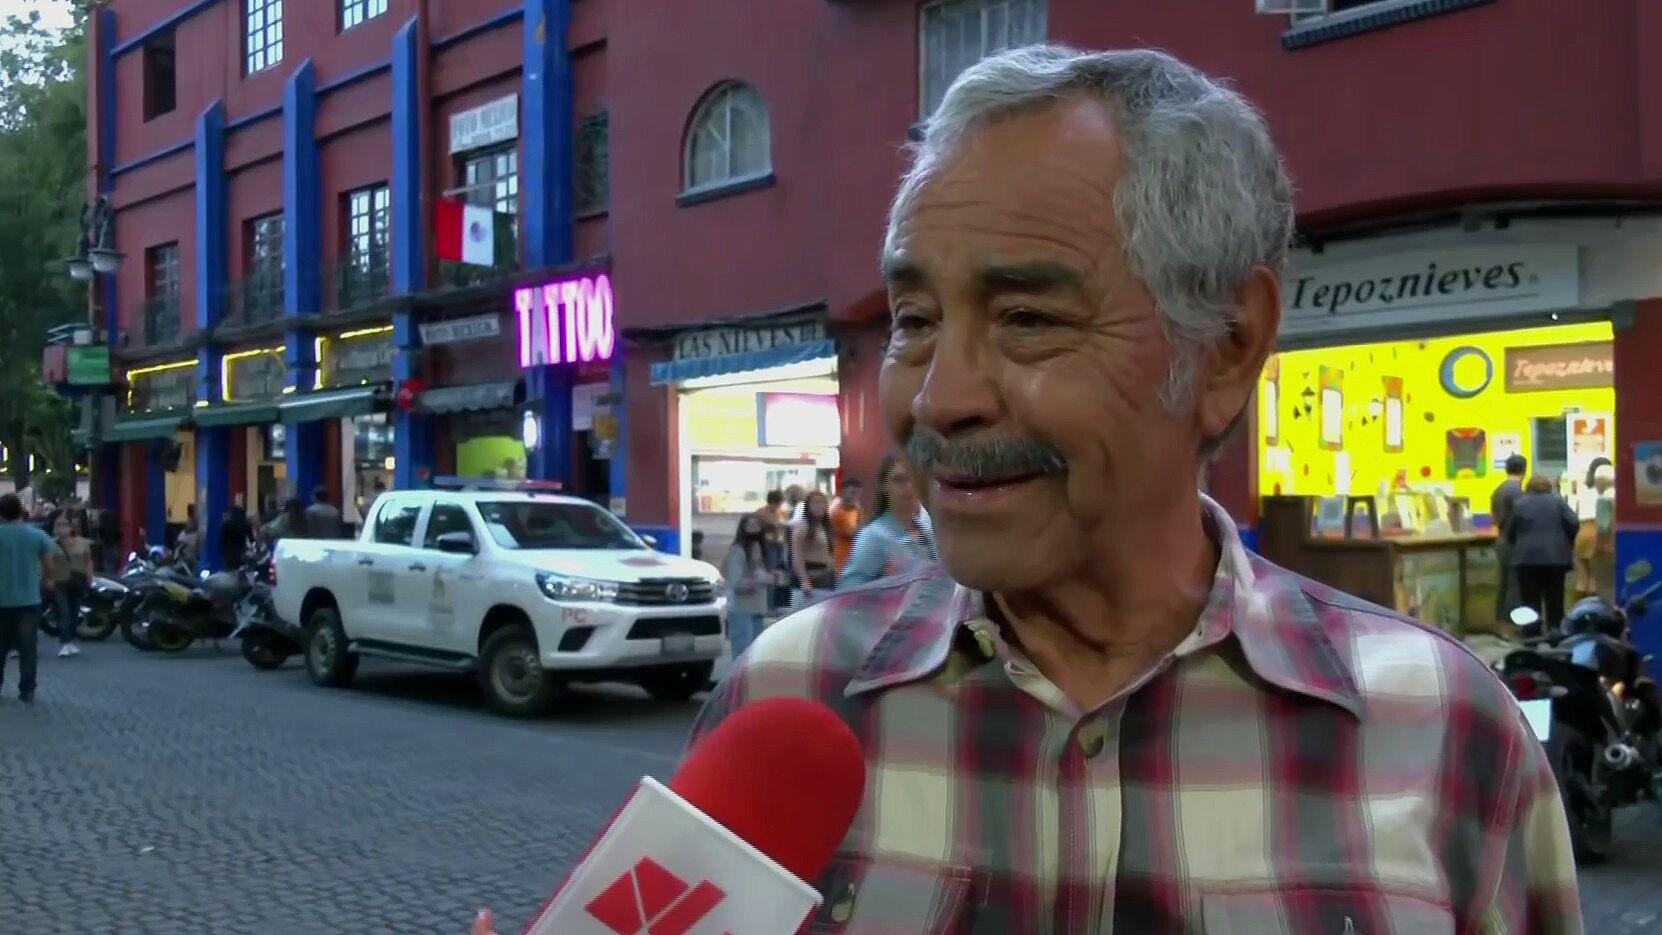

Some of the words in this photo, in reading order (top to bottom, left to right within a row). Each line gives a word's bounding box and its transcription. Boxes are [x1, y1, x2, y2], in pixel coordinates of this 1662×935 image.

[1292, 260, 1525, 314] Tepoznieves
[514, 275, 614, 368] TATTOO
[561, 607, 588, 624] PC
